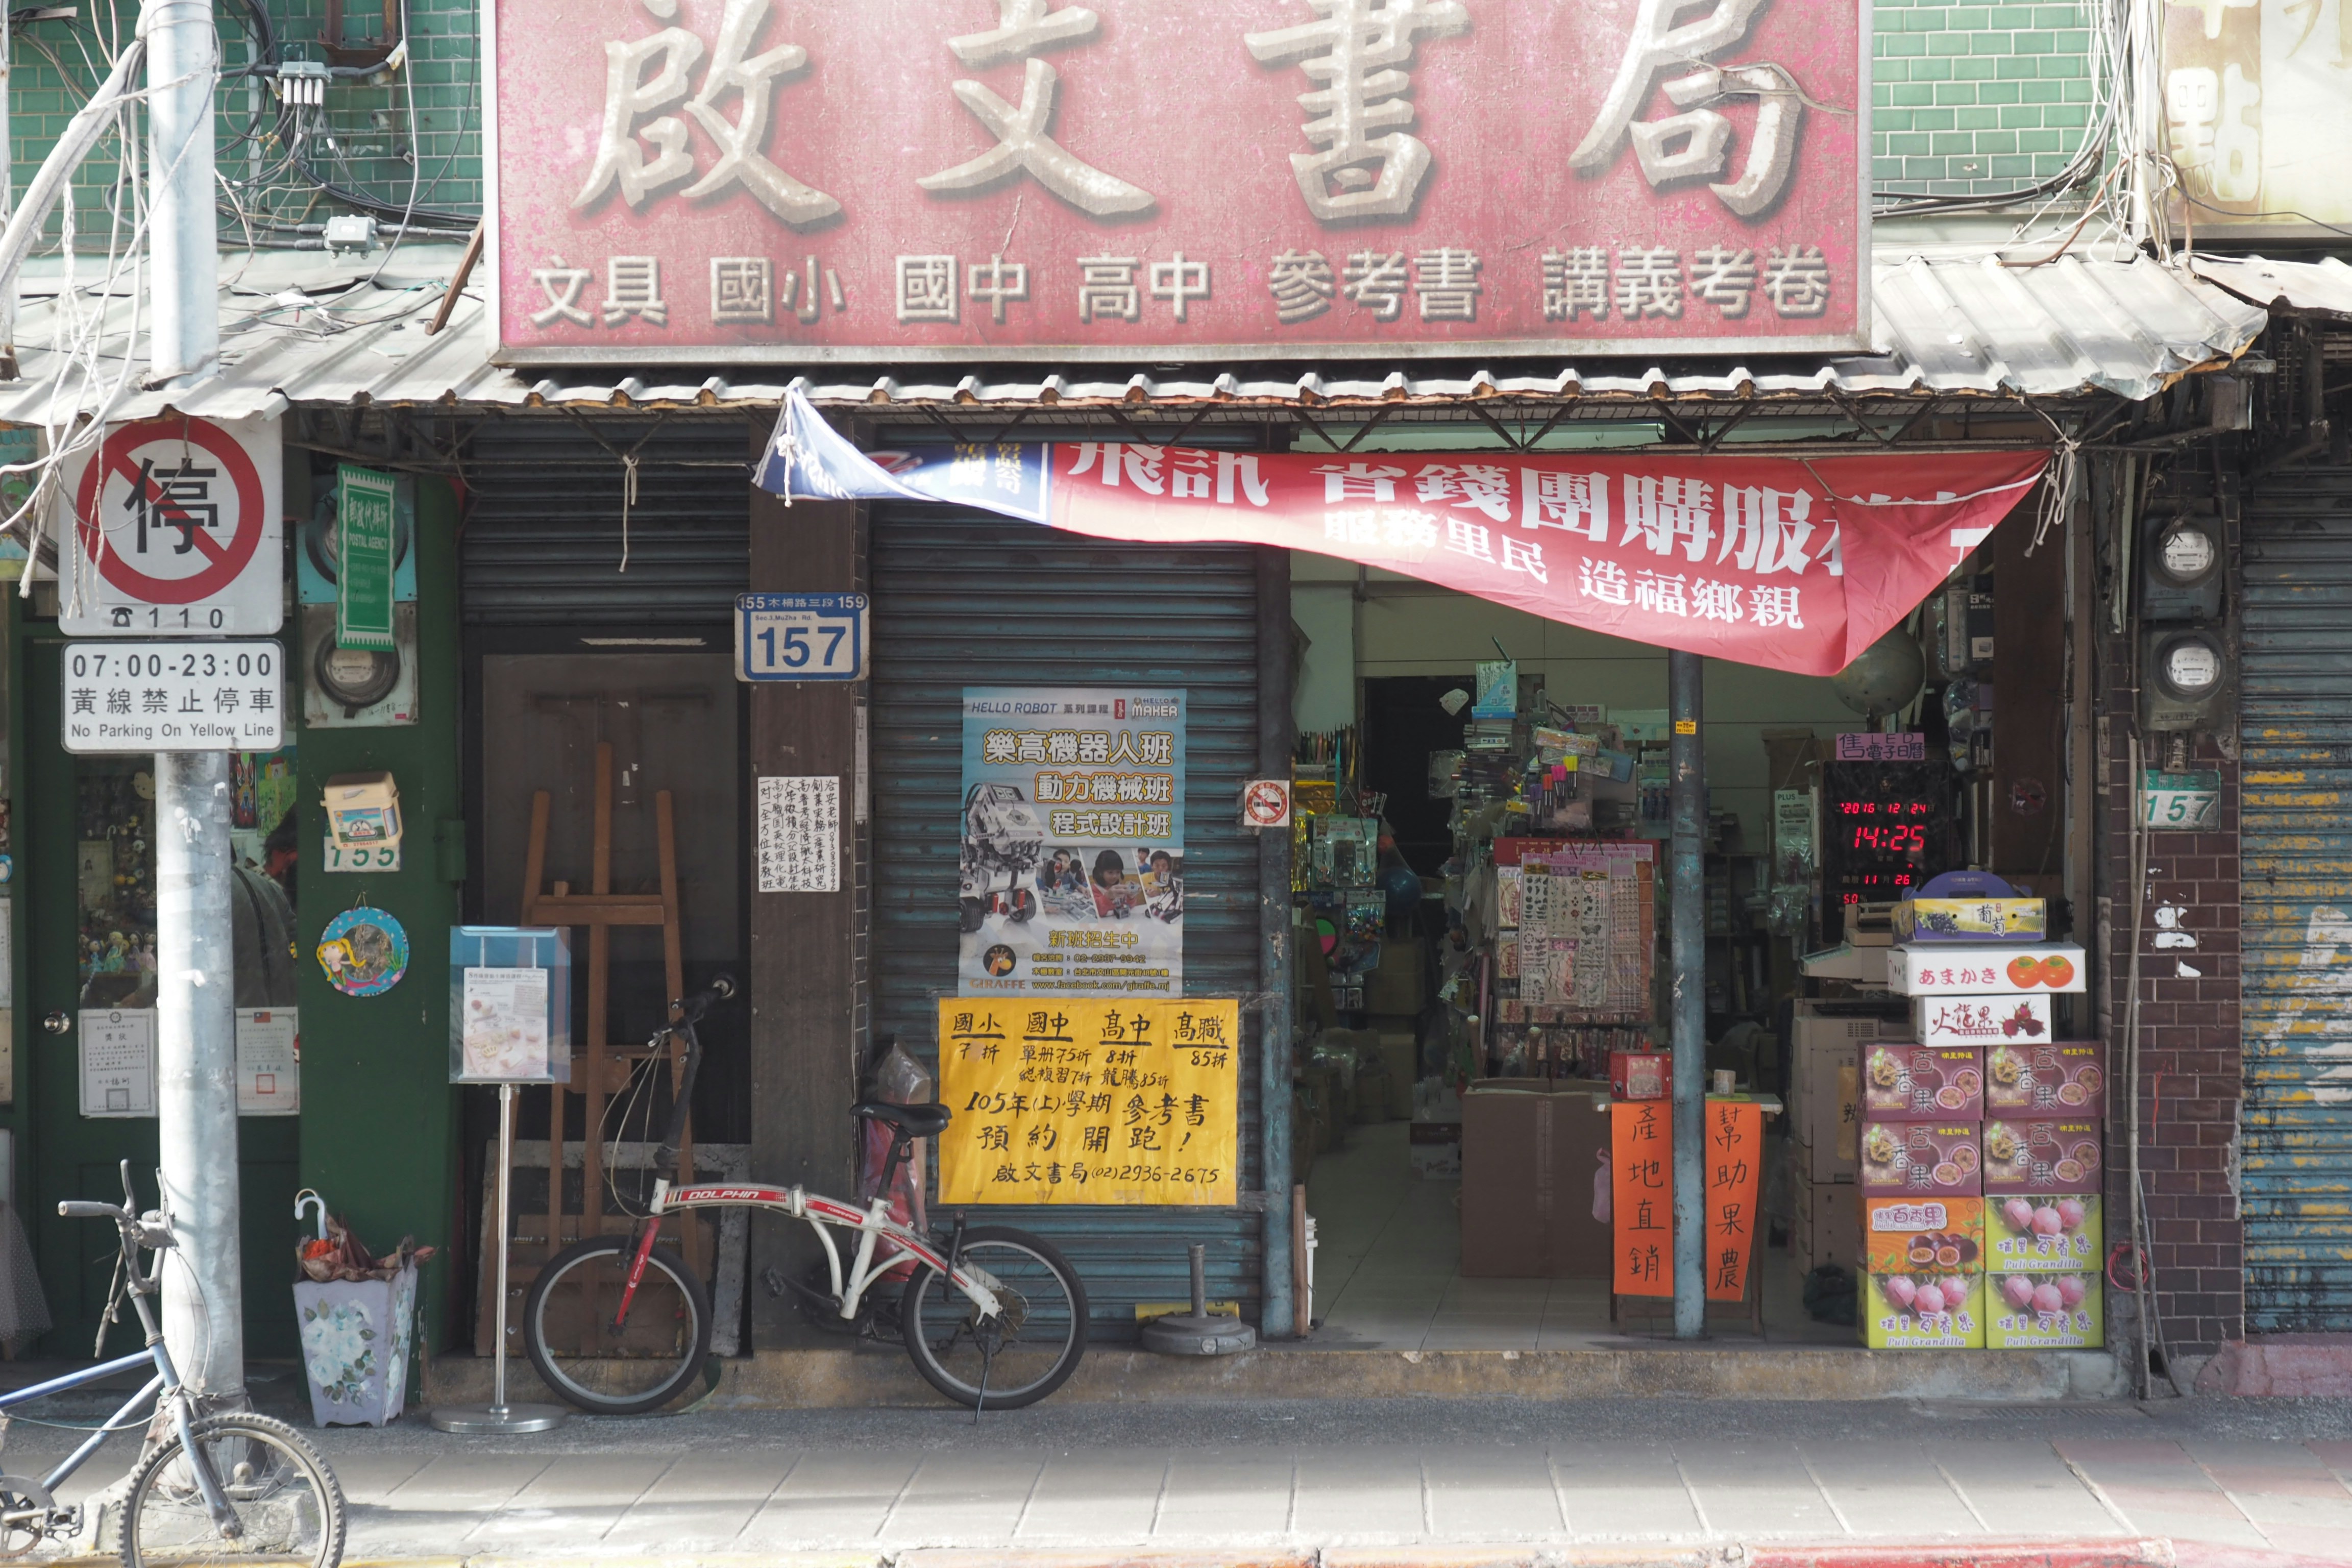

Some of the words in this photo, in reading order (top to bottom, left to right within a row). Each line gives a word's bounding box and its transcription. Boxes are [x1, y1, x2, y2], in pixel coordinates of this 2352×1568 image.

[531, 254, 667, 326] 文具
[710, 255, 846, 324] 國小
[896, 254, 1027, 323] 國中
[1077, 252, 1210, 323] 高中
[1269, 247, 1481, 323] 參考書
[1542, 244, 1828, 321] 講義考卷
[124, 457, 218, 554] 停
[349, 533, 368, 548] POSTAL
[368, 536, 387, 551] AGENCY
[1325, 509, 1548, 584] 服務里民
[1578, 556, 1804, 629] 造福鄉親
[739, 596, 765, 609] 155
[768, 598, 834, 608] 木柵路三段
[838, 596, 864, 609] 159
[149, 608, 223, 628] 110
[757, 626, 846, 668] 157
[72, 654, 271, 677] 07:00-23:00
[71, 688, 275, 715] 黃線禁止停車
[972, 702, 1011, 714] HELLO
[1015, 702, 1058, 714] ROBOT
[1064, 703, 1109, 714] 系列課程
[1132, 705, 1178, 717] MAKER
[72, 724, 90, 738] No
[100, 723, 152, 740] Parking
[162, 723, 181, 738] On
[190, 723, 236, 738] Yellow
[245, 723, 274, 738] Line
[984, 730, 1172, 766] 樂高機器人班
[1839, 733, 1865, 758] 售
[1872, 733, 1914, 744] LED
[1866, 742, 1924, 760] 電子日曆
[1037, 774, 1171, 803] 動力機械班
[2147, 795, 2214, 822] 157
[1052, 811, 1170, 838] 程式設計班
[1854, 825, 1924, 851] 14:25
[331, 846, 395, 867] 155
[1977, 903, 2005, 936] 葡萄
[1048, 930, 1139, 949] 新班招生中
[1074, 954, 1146, 964] 02-2937-9942
[969, 979, 1026, 990] GIRAFFE
[1032, 980, 1170, 992] www.facebook.com/giraffe.mj
[1919, 968, 1996, 985] あまかき
[953, 1012, 1002, 1033] 國小
[1026, 1011, 1069, 1035] 國中
[1099, 1009, 1150, 1040] 高中
[1174, 1011, 1225, 1043] 高職
[1106, 1049, 1138, 1068] 8折
[1191, 1050, 1229, 1069] 85折
[1893, 1050, 1937, 1114] 百香果
[2015, 1047, 2057, 1110] 百香果
[1122, 1093, 1209, 1126] 參考書
[1889, 1126, 1932, 1190] 百香果
[2012, 1123, 2054, 1187] 百香果
[688, 1190, 760, 1200] DOLPHIN
[1628, 1105, 1666, 1282] 產地直銷
[1712, 1106, 1748, 1290] 幫助果農
[2004, 1259, 2027, 1269] Puli
[2028, 1259, 2082, 1269] Grandilla
[1887, 1337, 1909, 1348] Puli
[1910, 1336, 1966, 1346] Grandilla
[2005, 1336, 2028, 1347] Puli
[2029, 1336, 2085, 1346] Grandilla
